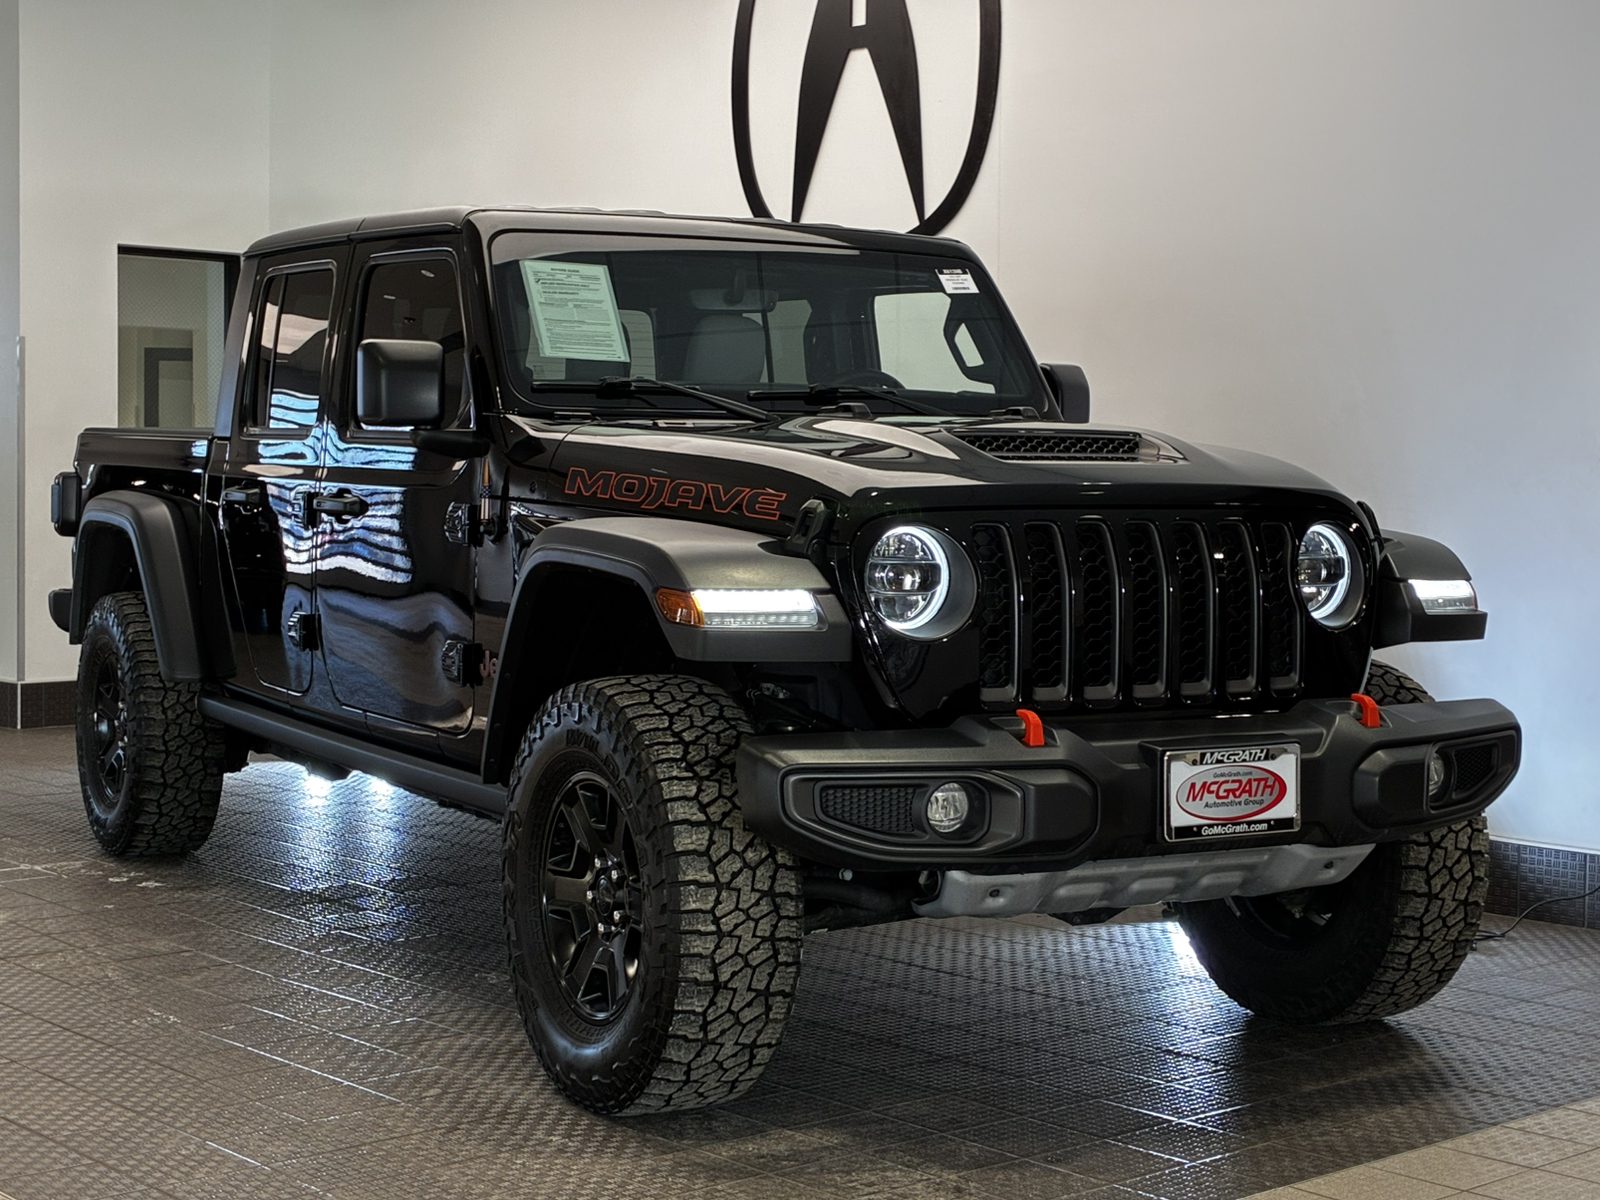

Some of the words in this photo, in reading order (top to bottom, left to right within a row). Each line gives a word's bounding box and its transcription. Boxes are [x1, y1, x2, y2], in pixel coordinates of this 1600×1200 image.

[564, 467, 787, 521] MOJAVE
[1213, 770, 1253, 779] GoMcGrath.com
[1203, 800, 1242, 809] Automotive
[1243, 798, 1265, 807] Group
[1201, 822, 1268, 836] GoMcGrath.com
